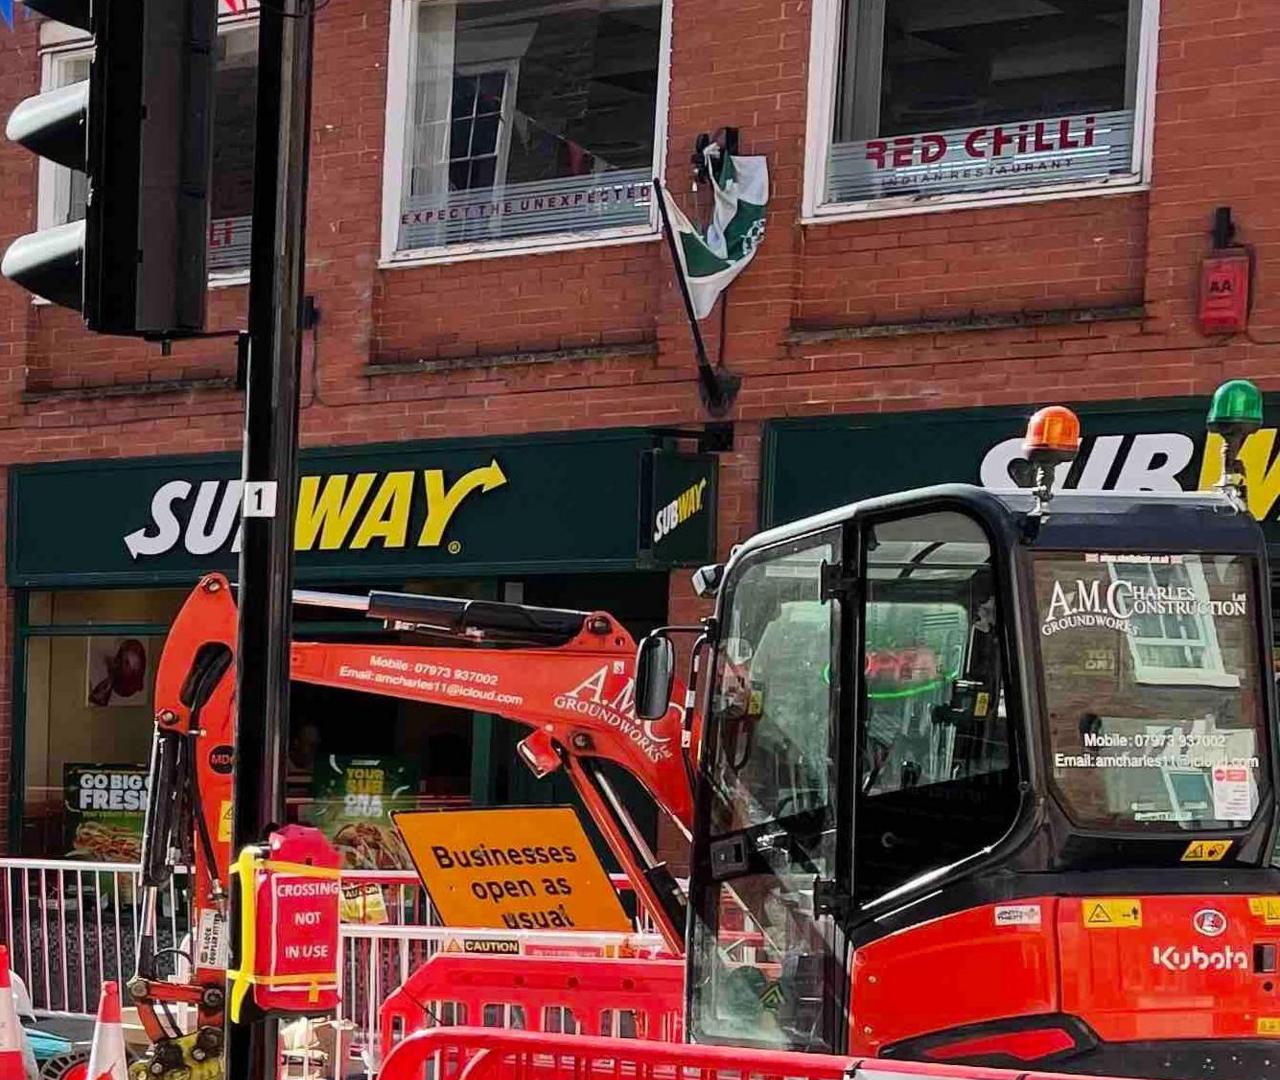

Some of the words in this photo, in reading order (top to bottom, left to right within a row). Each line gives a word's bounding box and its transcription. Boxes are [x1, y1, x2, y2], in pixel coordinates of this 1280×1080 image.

[866, 135, 947, 169] RED
[951, 161, 1073, 180] RESTAURANT
[401, 207, 470, 225] EXPECT
[480, 202, 513, 214] THE
[520, 187, 649, 211] UNEXPECTED
[124, 457, 507, 560] SUWAY
[253, 488, 263, 511] 1
[653, 476, 707, 543] SUBWAY
[1041, 614, 1139, 636] GROUNDWORKS
[415, 663, 451, 678] 07973
[454, 669, 498, 685] 937002
[554, 695, 664, 764] GROUNDWORKS
[1134, 734, 1174, 748] 07973
[1179, 734, 1227, 748] 937002
[80, 773, 108, 789] GO
[110, 773, 140, 790] BIG
[431, 843, 577, 869] Businesses
[277, 882, 340, 898] CROSSING
[471, 878, 536, 904] open
[541, 876, 572, 895] as
[294, 911, 321, 926] NOT
[502, 904, 575, 930] usual
[285, 946, 300, 959] IN
[303, 944, 329, 959] USE
[466, 940, 519, 953] CAUTION
[1153, 945, 1248, 970] Kubota
